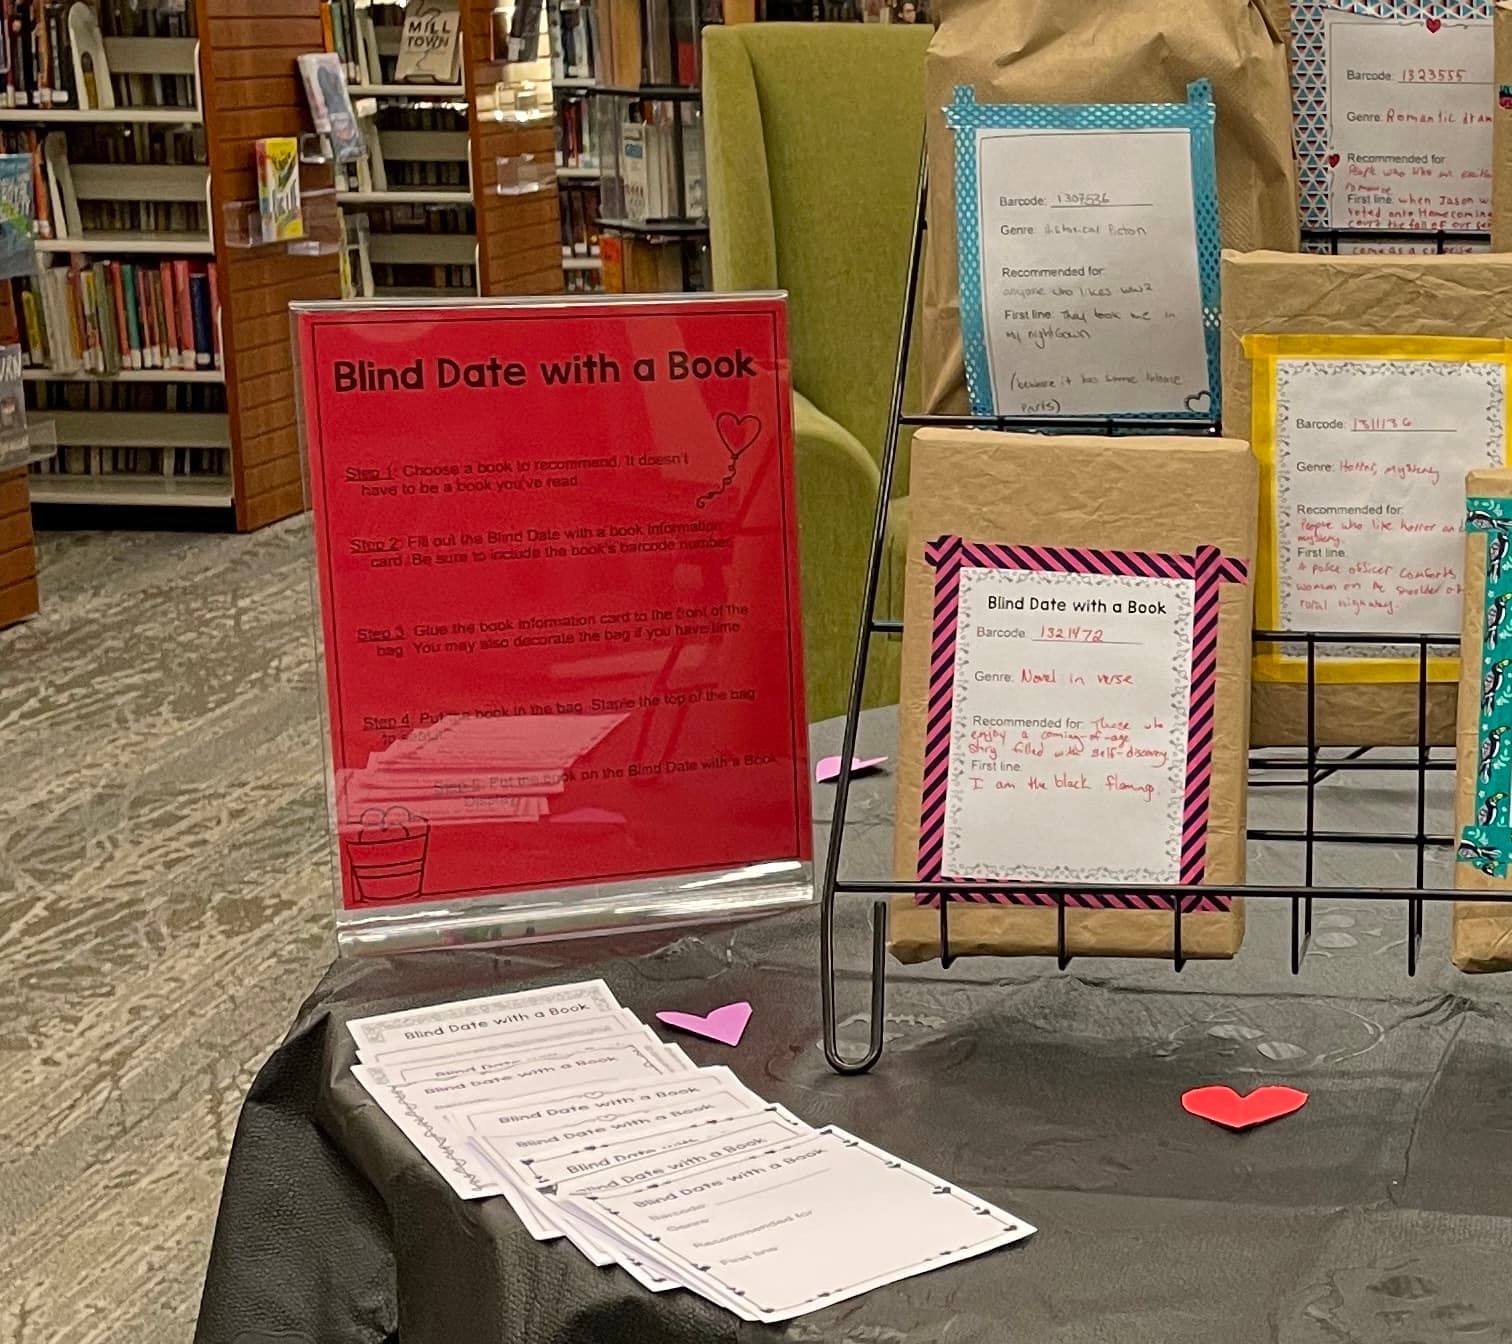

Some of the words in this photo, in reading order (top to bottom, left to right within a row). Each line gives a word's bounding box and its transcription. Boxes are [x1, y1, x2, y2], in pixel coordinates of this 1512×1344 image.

[408, 20, 451, 34] MILL
[408, 36, 449, 49] TOWN
[334, 360, 426, 394] Blind
[437, 359, 527, 389] Date
[540, 353, 622, 385] with
[633, 359, 656, 382] a
[668, 348, 758, 381] Book
[988, 596, 1024, 611] Blind
[1030, 597, 1066, 612] Date
[1073, 599, 1107, 613] with
[1112, 603, 1122, 614] a
[1128, 600, 1167, 615] Book
[404, 1027, 444, 1040] Blind
[449, 1020, 488, 1033] Date
[493, 1010, 529, 1025] with
[534, 1011, 545, 1019] a
[549, 1003, 590, 1016] Book
